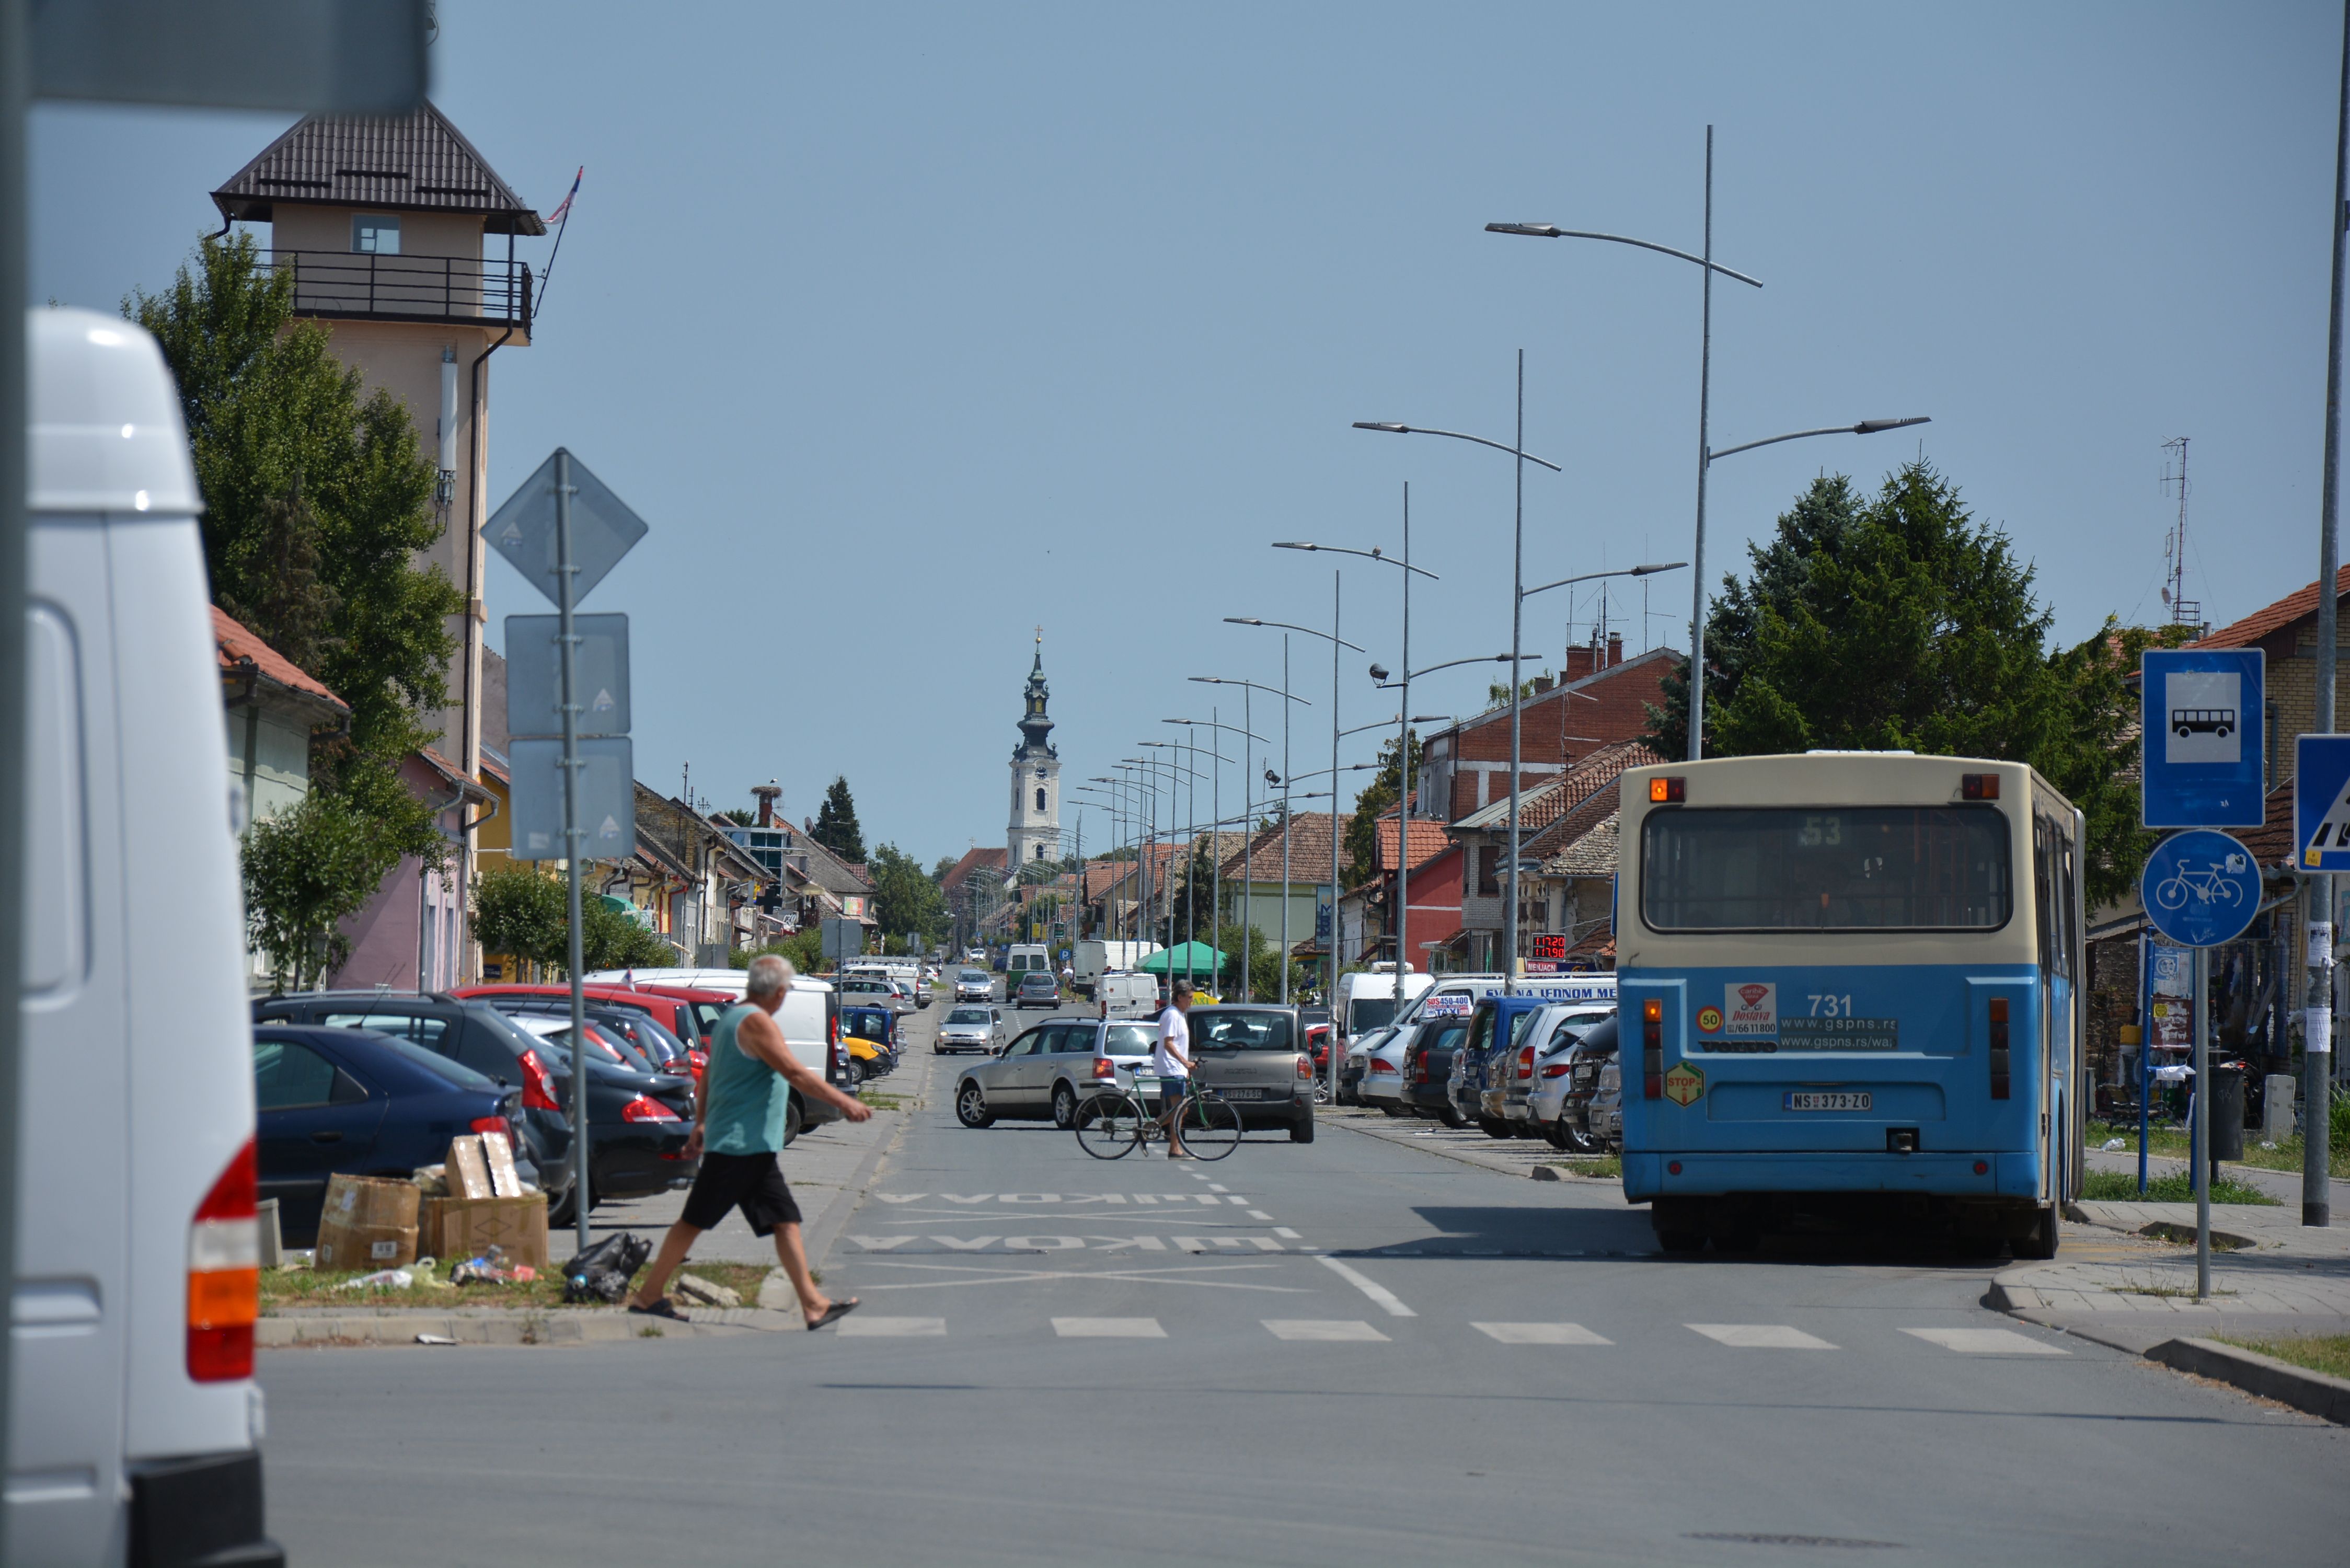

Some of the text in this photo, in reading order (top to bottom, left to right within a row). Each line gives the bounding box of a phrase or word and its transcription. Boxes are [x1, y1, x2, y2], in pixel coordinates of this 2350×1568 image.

[1806, 817, 1840, 845] 53
[1536, 937, 1565, 947] 117.20
[1062, 951, 1069, 959] P
[1536, 948, 1565, 958] 117.90
[1426, 996, 1468, 1006] SOS 450-400
[1807, 995, 1852, 1017] 731
[1435, 1008, 1459, 1017] TAXI
[1732, 1010, 1771, 1021] Dostava
[1702, 1015, 1718, 1025] 50
[1781, 1019, 1897, 1032] www.gspns.rs
[1668, 1077, 1696, 1087] STOP
[1794, 1094, 1811, 1108] NS
